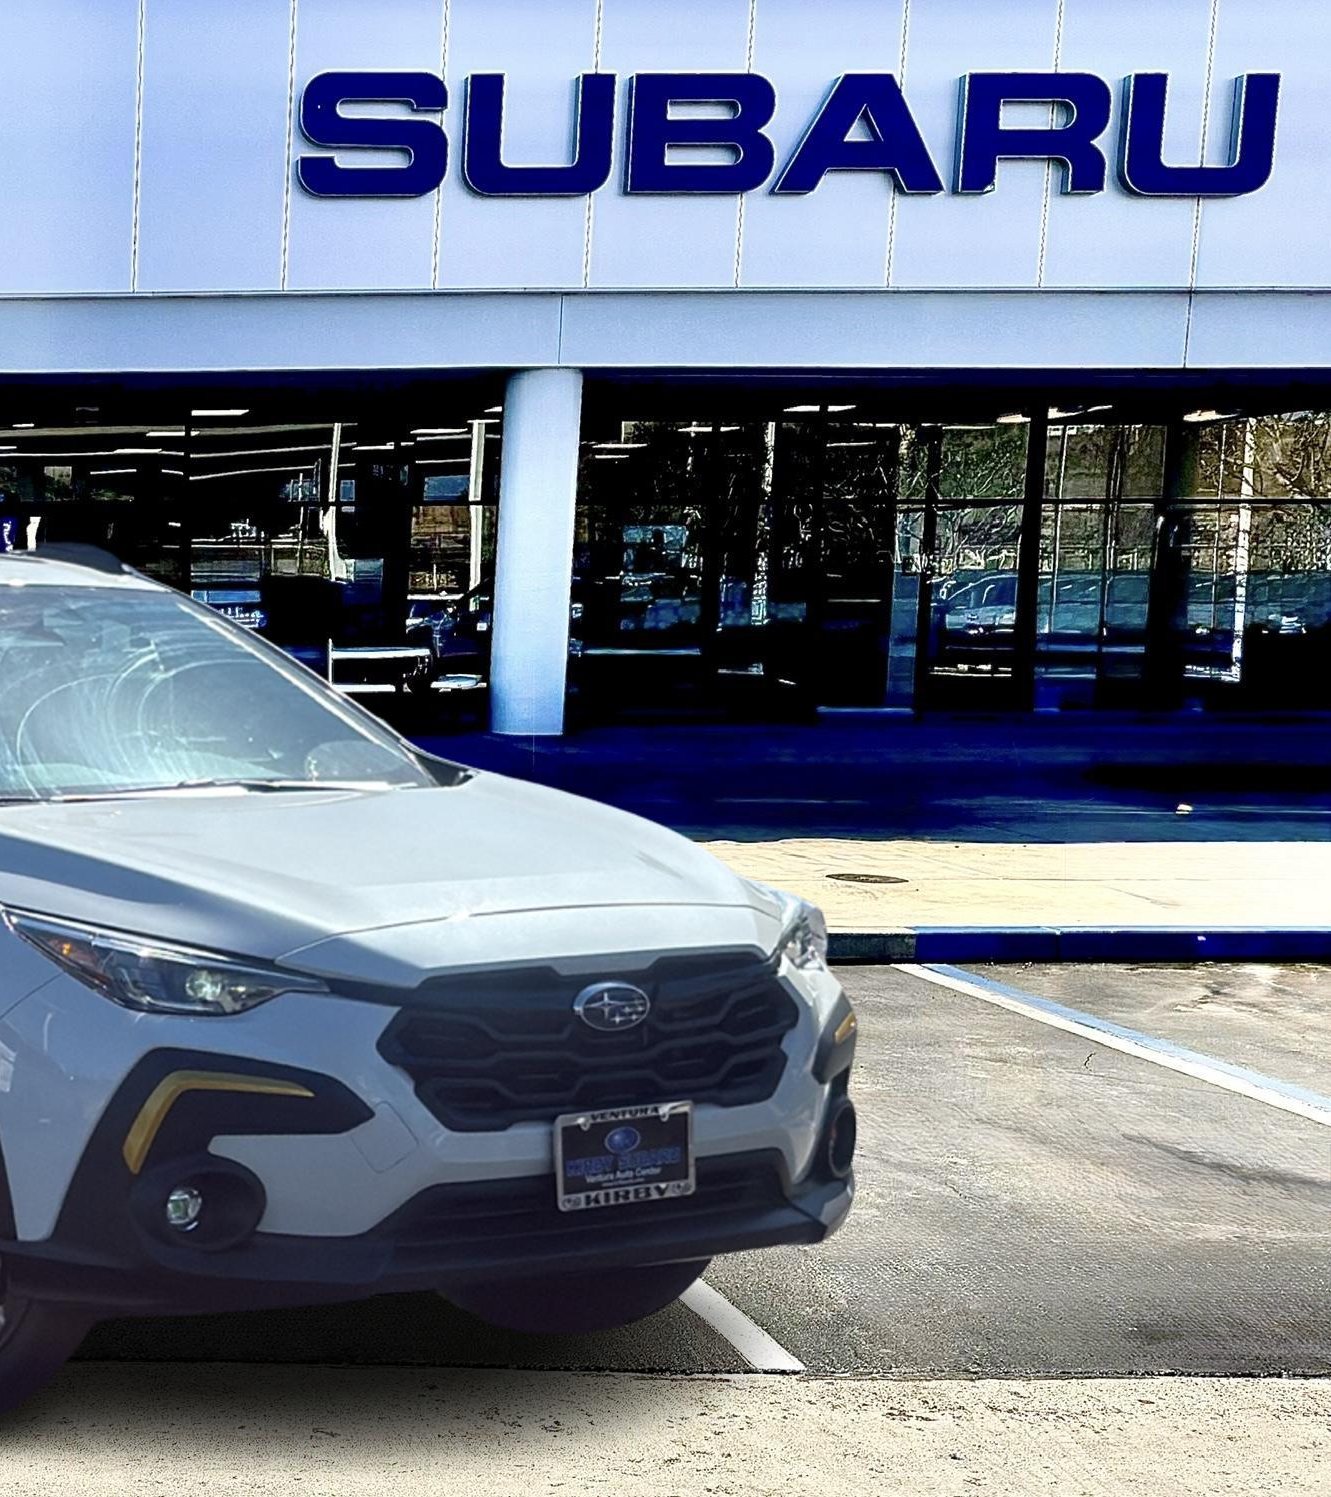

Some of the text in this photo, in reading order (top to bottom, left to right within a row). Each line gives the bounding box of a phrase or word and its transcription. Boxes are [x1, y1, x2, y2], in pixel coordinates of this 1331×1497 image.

[296, 71, 1281, 198] SUBARU
[590, 1106, 659, 1121] VENTURA
[615, 1169, 634, 1180] Auto
[635, 1166, 663, 1177] Center
[585, 1183, 669, 1206] KIRBY
